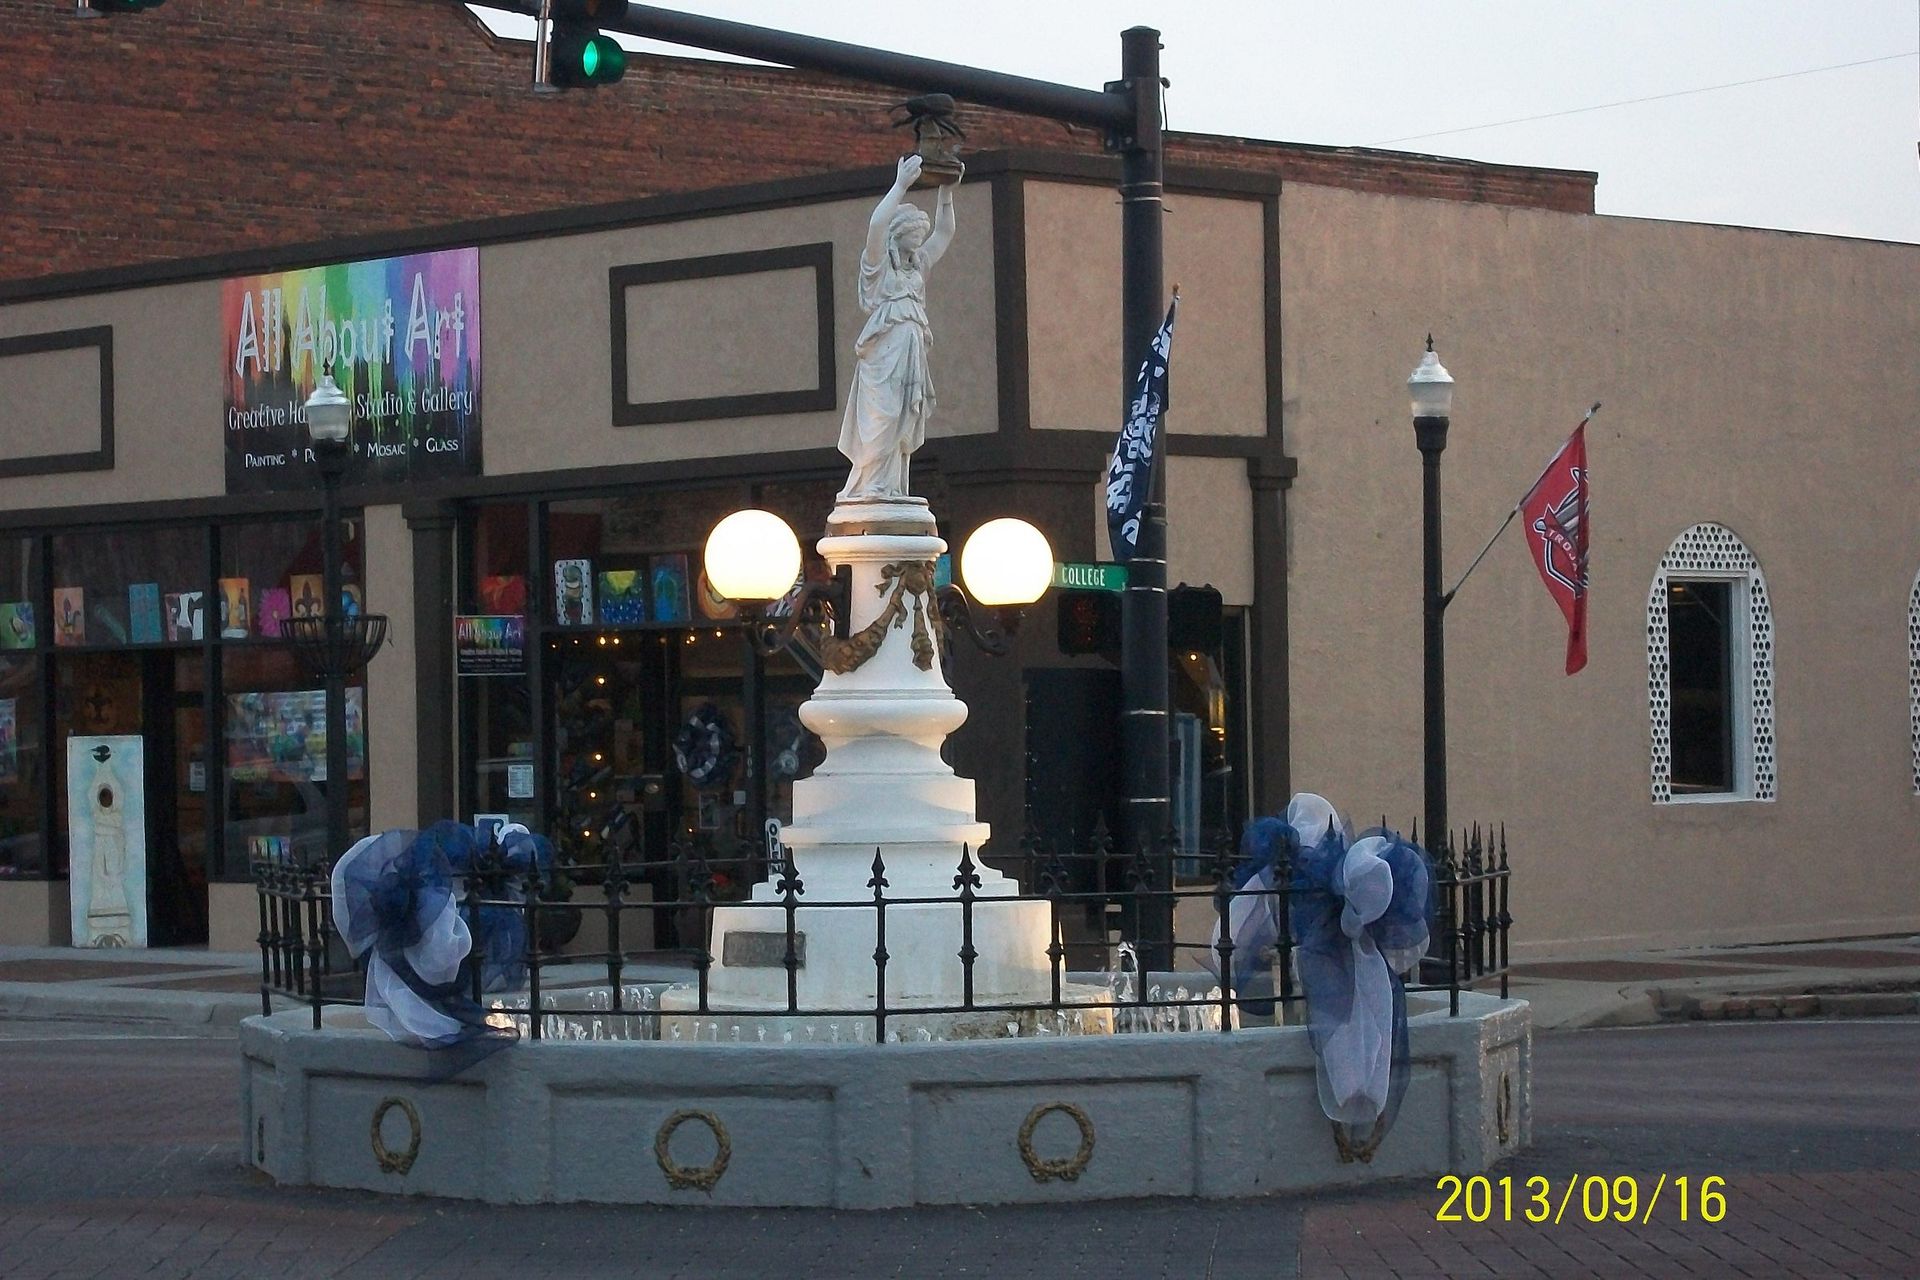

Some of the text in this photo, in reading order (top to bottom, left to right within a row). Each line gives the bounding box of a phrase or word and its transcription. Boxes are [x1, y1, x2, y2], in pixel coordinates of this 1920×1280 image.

[235, 271, 465, 379] All About Art
[228, 403, 285, 430] Creative
[357, 391, 403, 420] Studio
[407, 388, 417, 415] &
[421, 386, 473, 415] Gallery
[1062, 567, 1106, 587] COLLEGE
